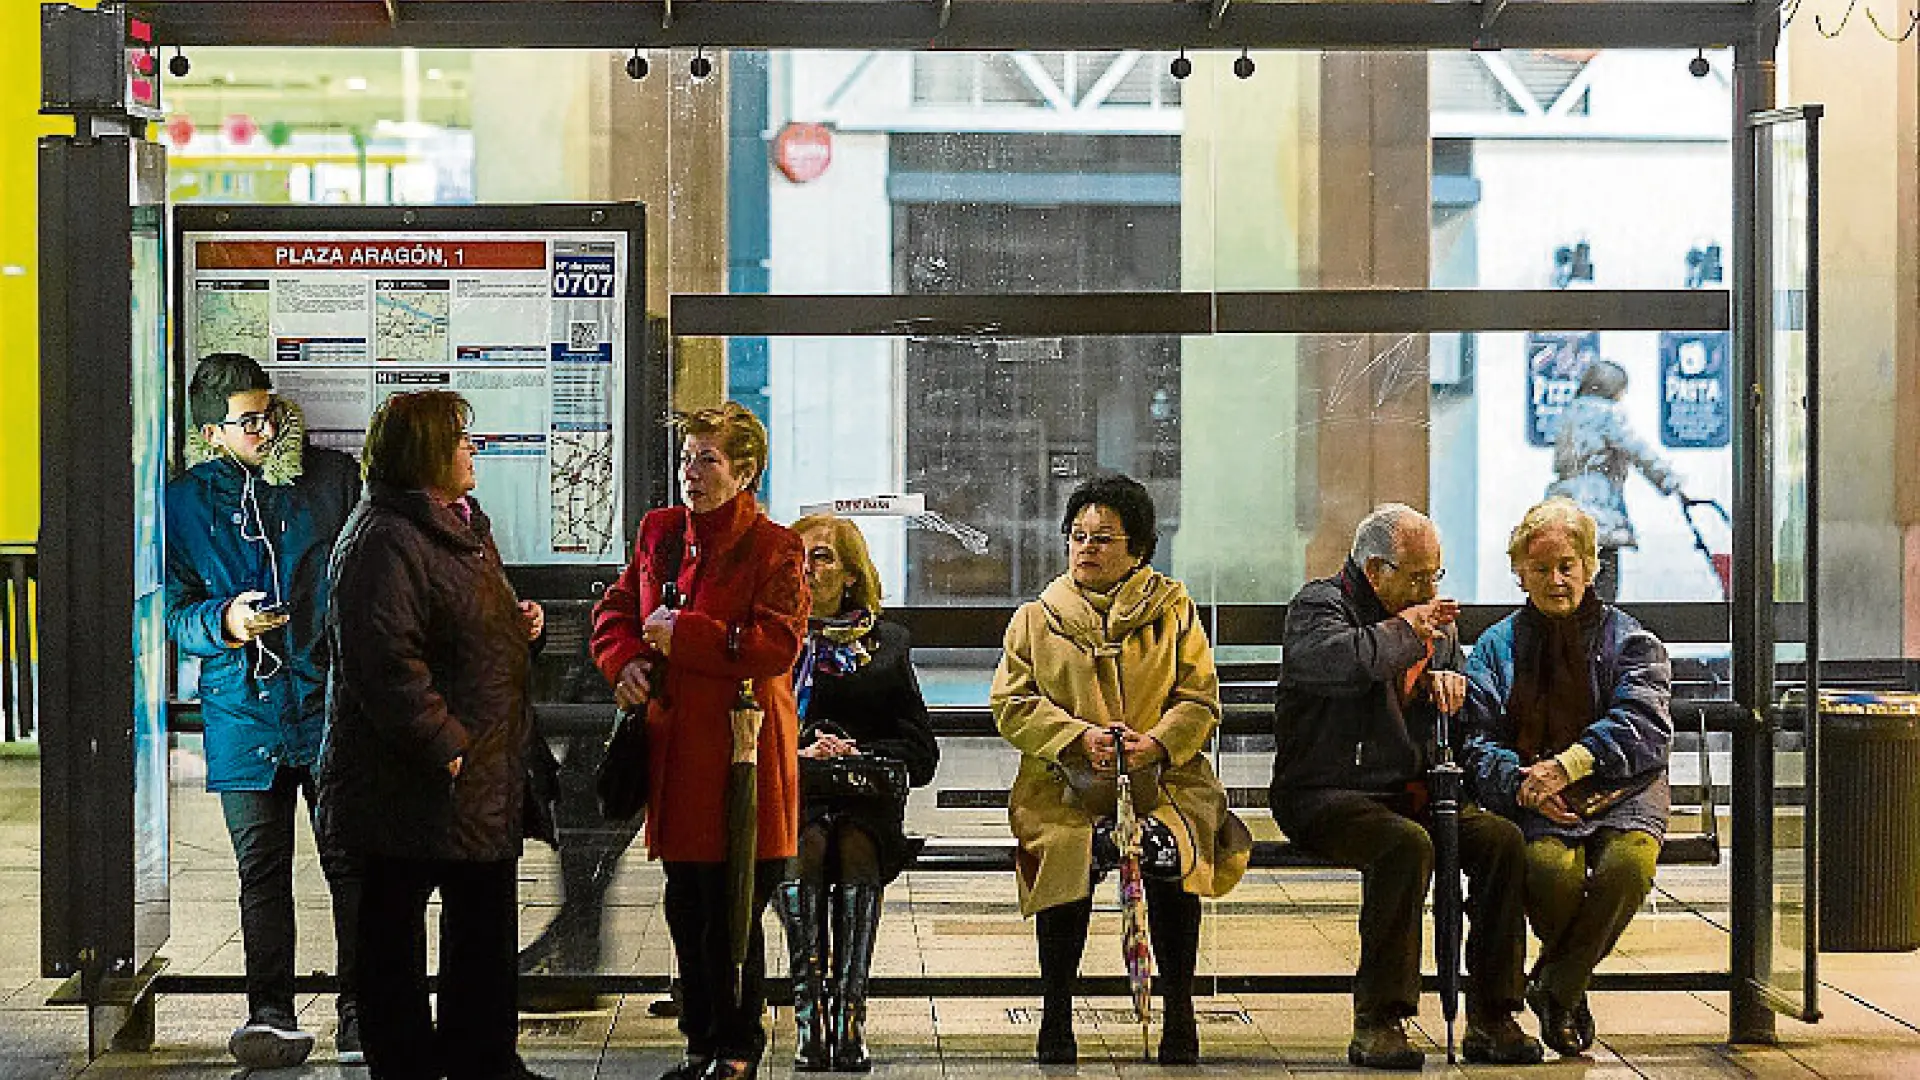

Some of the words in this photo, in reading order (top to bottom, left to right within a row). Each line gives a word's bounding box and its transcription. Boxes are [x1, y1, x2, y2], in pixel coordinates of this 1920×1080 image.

[276, 247, 344, 265] PLAZA
[350, 244, 448, 268] ARAGÓN,
[456, 248, 465, 265] 1
[554, 272, 613, 295] 0707
